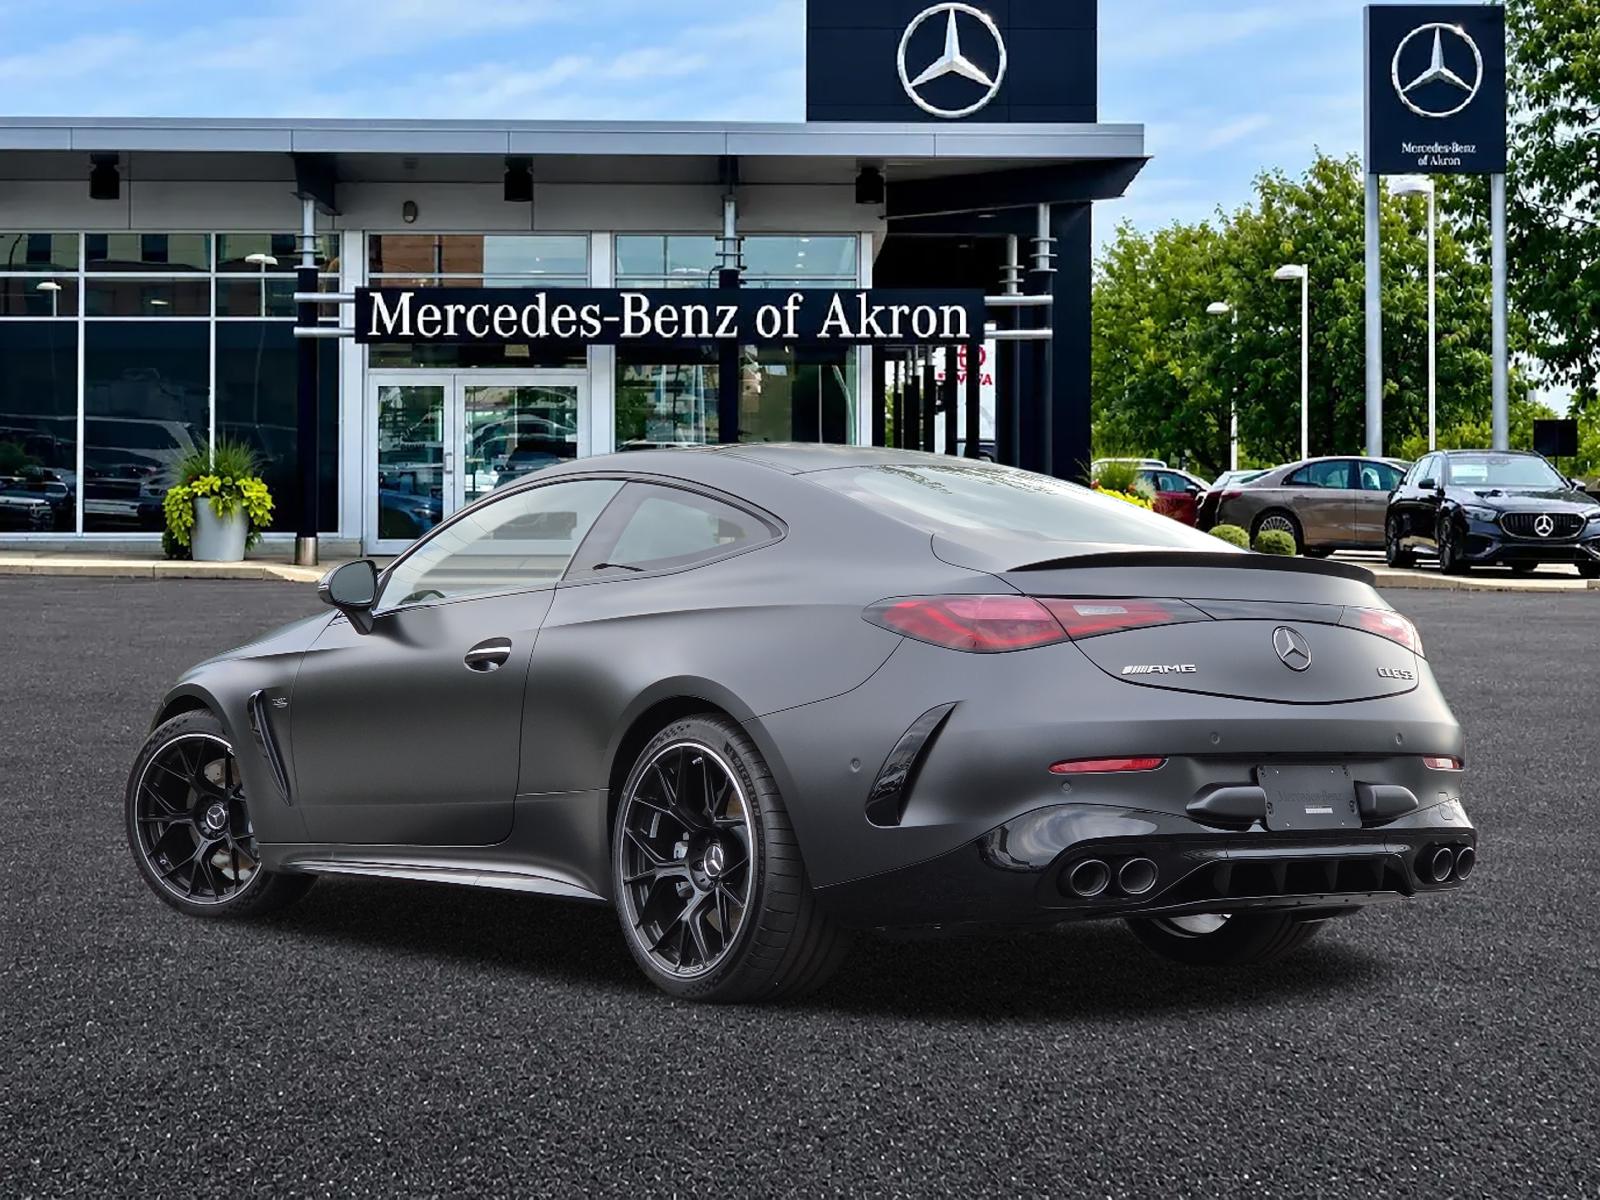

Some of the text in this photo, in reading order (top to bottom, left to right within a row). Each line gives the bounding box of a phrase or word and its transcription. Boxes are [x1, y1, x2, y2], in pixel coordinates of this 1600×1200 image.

[1401, 141, 1476, 153] Mercedes-Benz
[1417, 154, 1461, 166] of Akron
[367, 291, 971, 338] Mercedes-Benz of Akron
[1146, 664, 1197, 674] AMG
